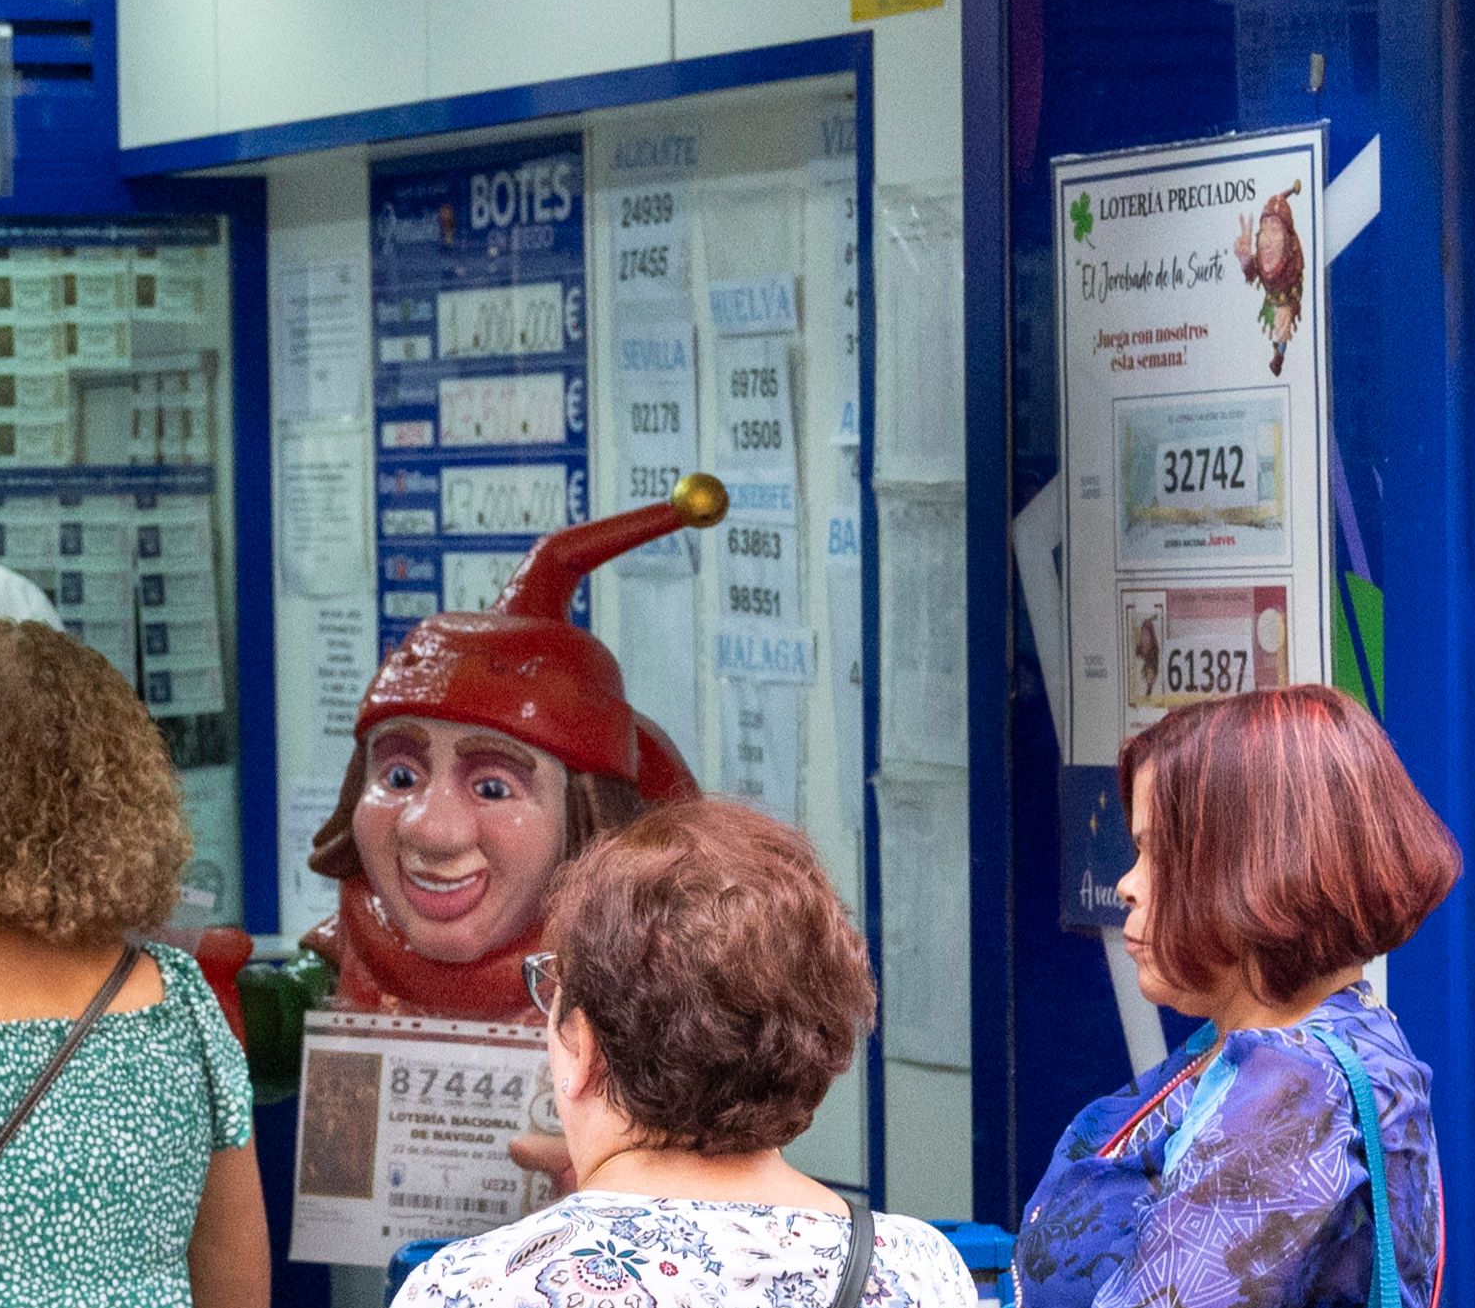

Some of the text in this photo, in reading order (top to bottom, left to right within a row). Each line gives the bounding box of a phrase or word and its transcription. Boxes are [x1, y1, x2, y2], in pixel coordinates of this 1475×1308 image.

[469, 160, 572, 229] BOTES
[1099, 178, 1256, 221] LOTERÍA PRECIADOS
[1098, 260, 1152, 304] Jorobado
[1154, 257, 1170, 291] de
[1172, 255, 1184, 291] la
[1132, 331, 1154, 345] con
[1155, 322, 1209, 344] nosotros
[1110, 354, 1135, 372] esta
[1163, 444, 1245, 494] 32742
[1167, 649, 1248, 693] 61387
[390, 1066, 524, 1101] 87444
